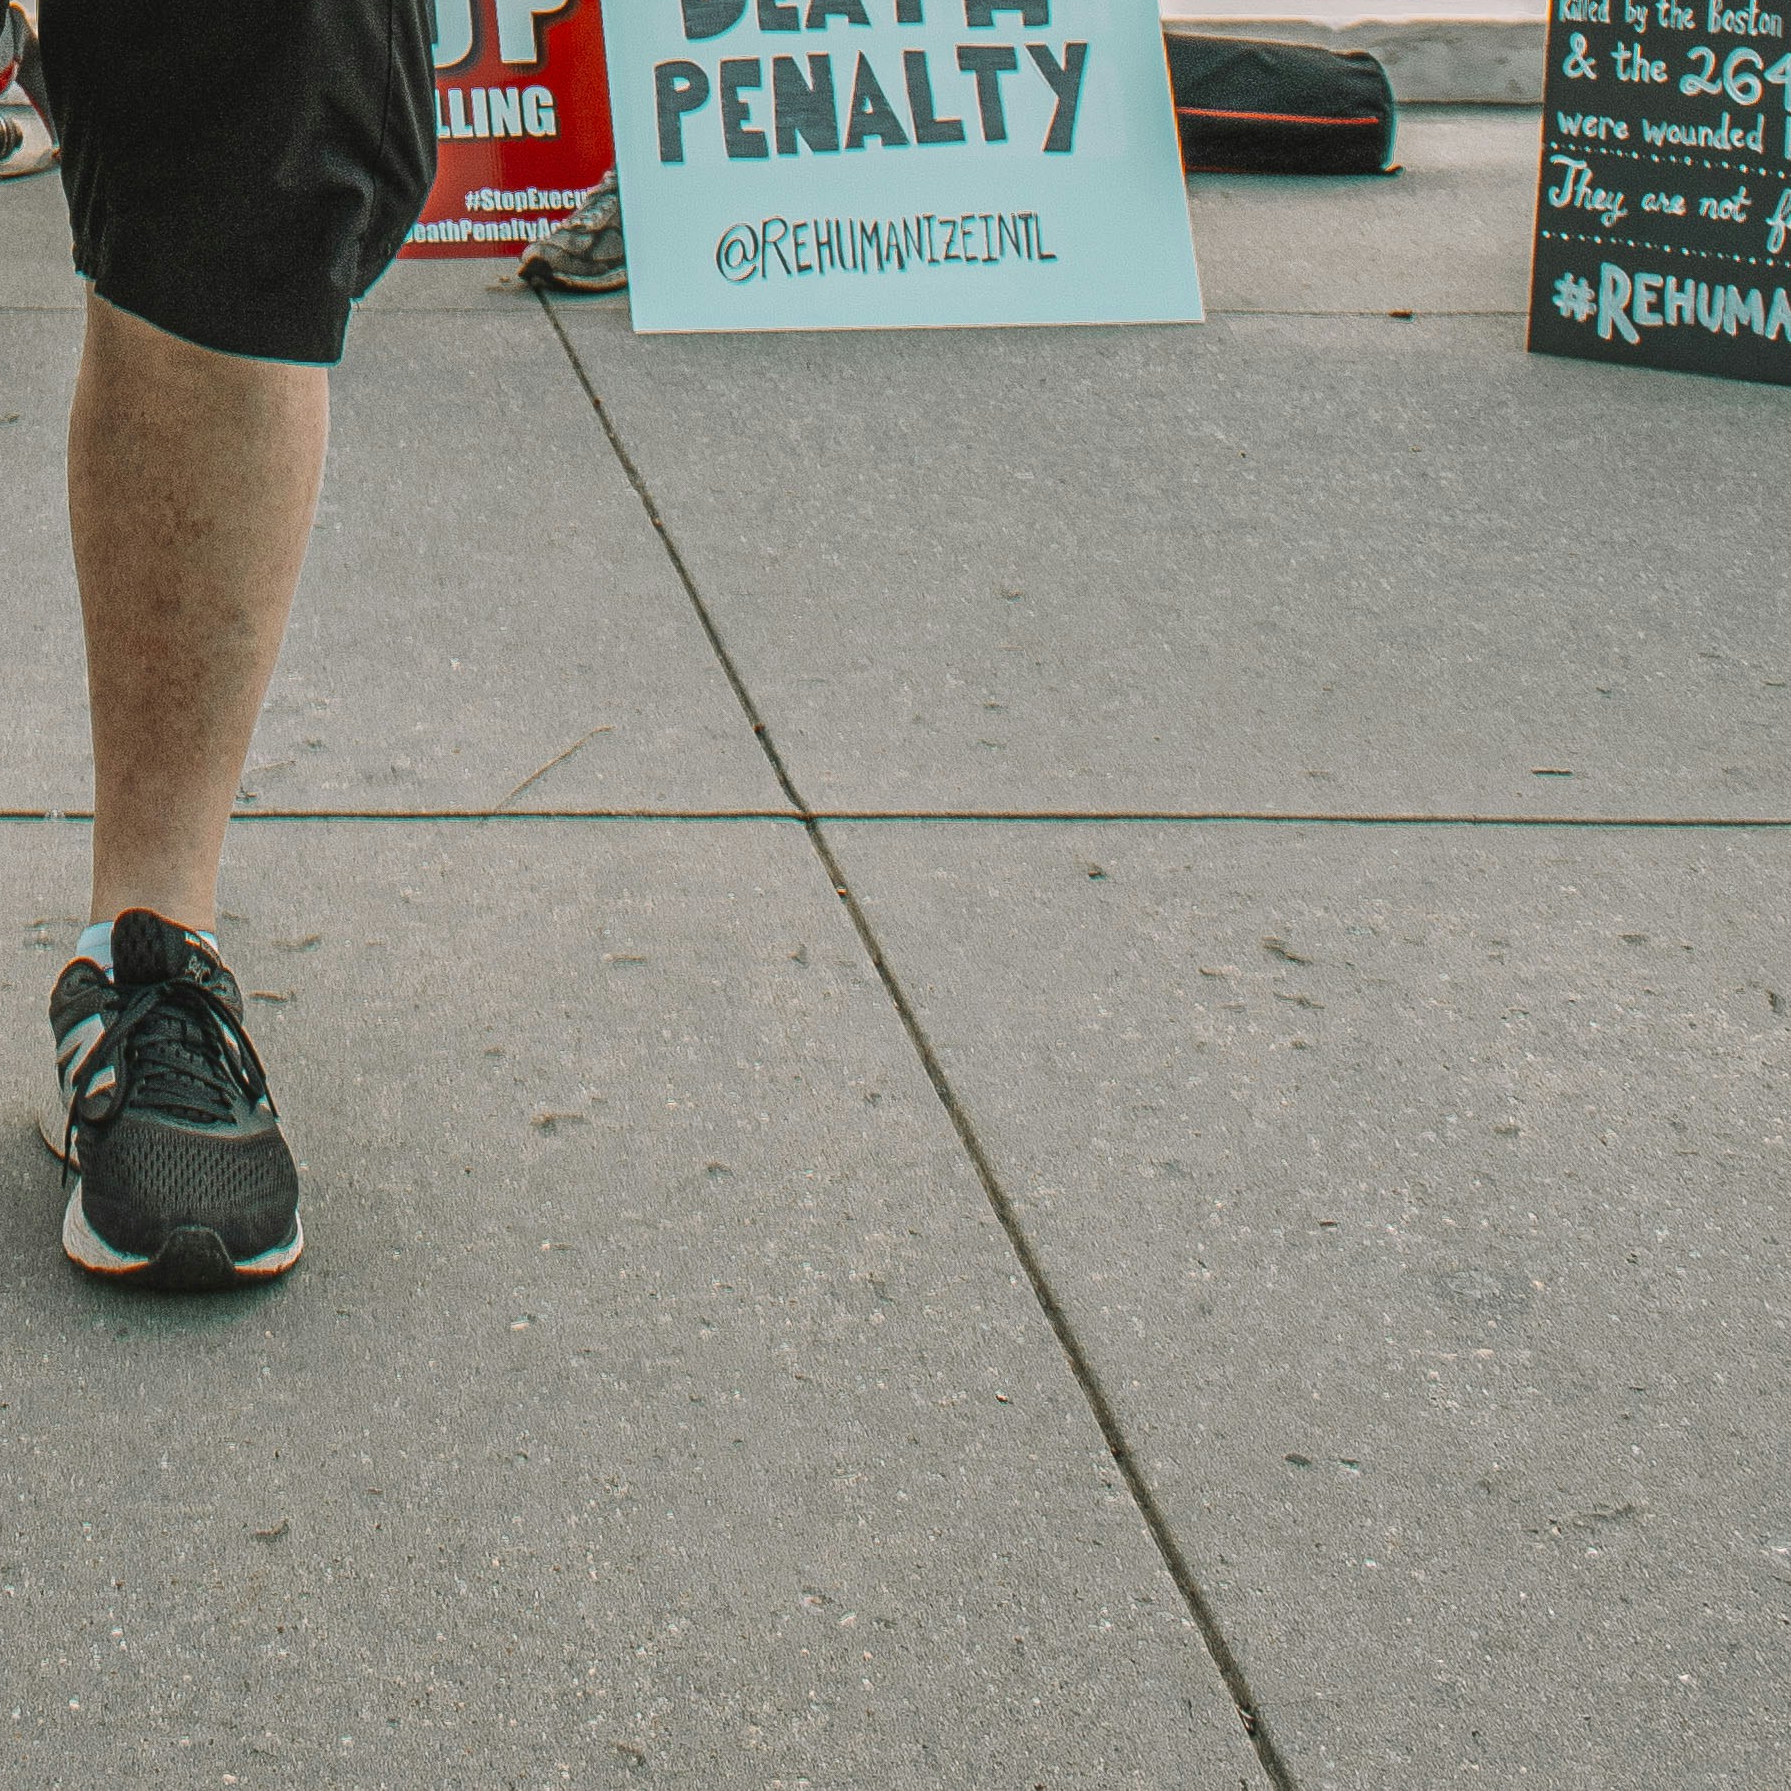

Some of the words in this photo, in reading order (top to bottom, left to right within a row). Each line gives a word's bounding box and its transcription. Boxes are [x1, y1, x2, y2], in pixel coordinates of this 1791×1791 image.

[653, 40, 1088, 164] PENALTY
[1562, 31, 1597, 80] &
[1611, 41, 1668, 84] the
[1679, 46, 1791, 112] 264
[1557, 111, 1629, 141] were
[1642, 111, 1764, 154] wounded
[1549, 154, 1628, 227] They
[1641, 192, 1686, 216] are
[1699, 186, 1752, 224] not
[715, 212, 1057, 282] @REHUMANIZEINTL
[1552, 262, 1791, 345] #REHUMA
